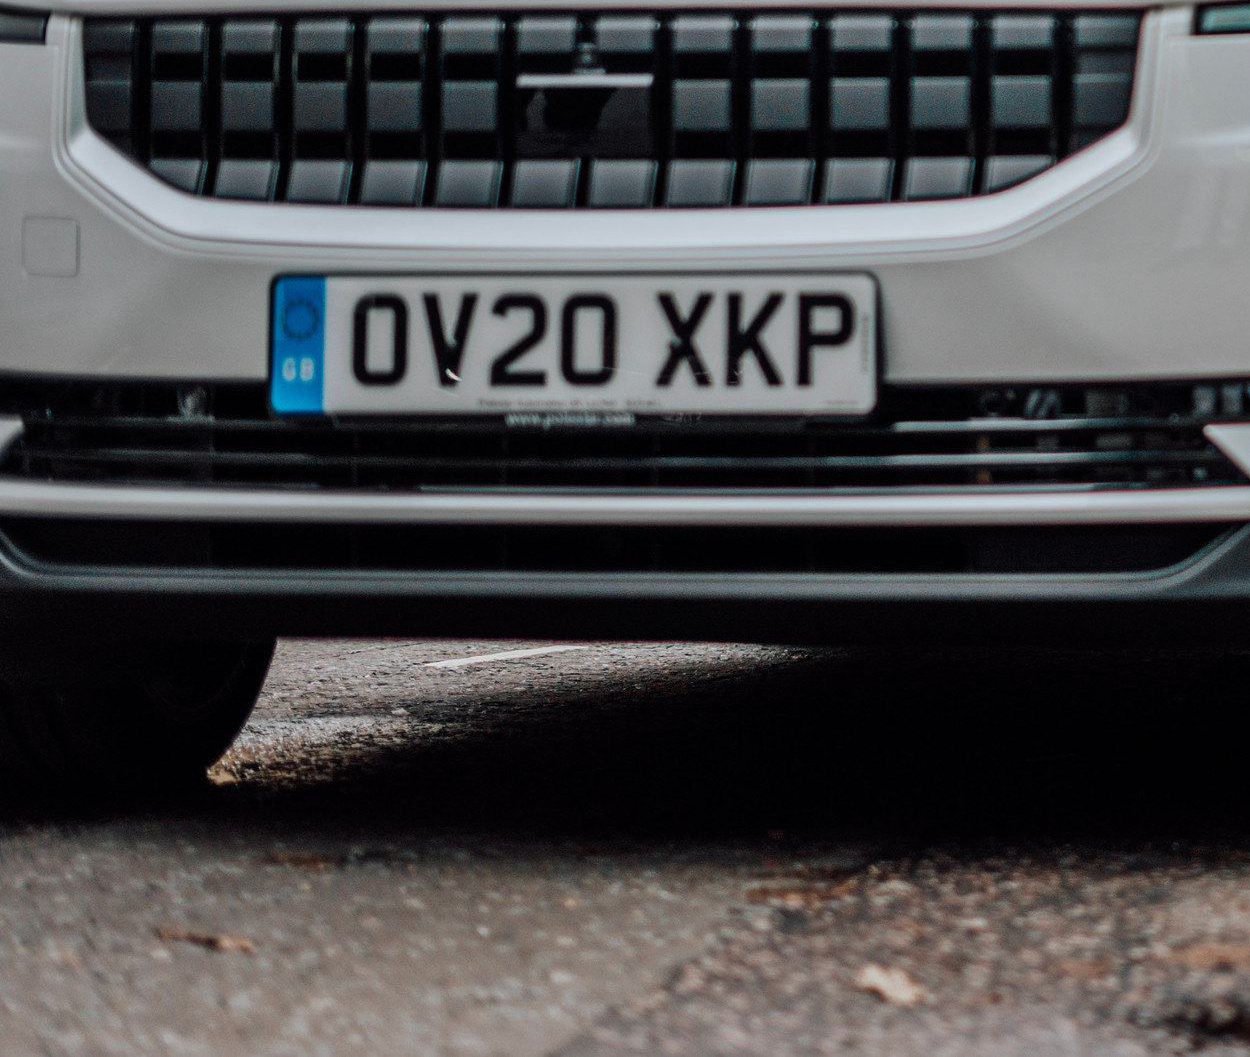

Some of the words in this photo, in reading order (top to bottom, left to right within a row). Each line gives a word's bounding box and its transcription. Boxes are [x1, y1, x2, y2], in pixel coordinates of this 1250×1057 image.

[352, 292, 621, 386] OV20
[656, 292, 858, 386] XKP
[282, 357, 315, 382] GB
